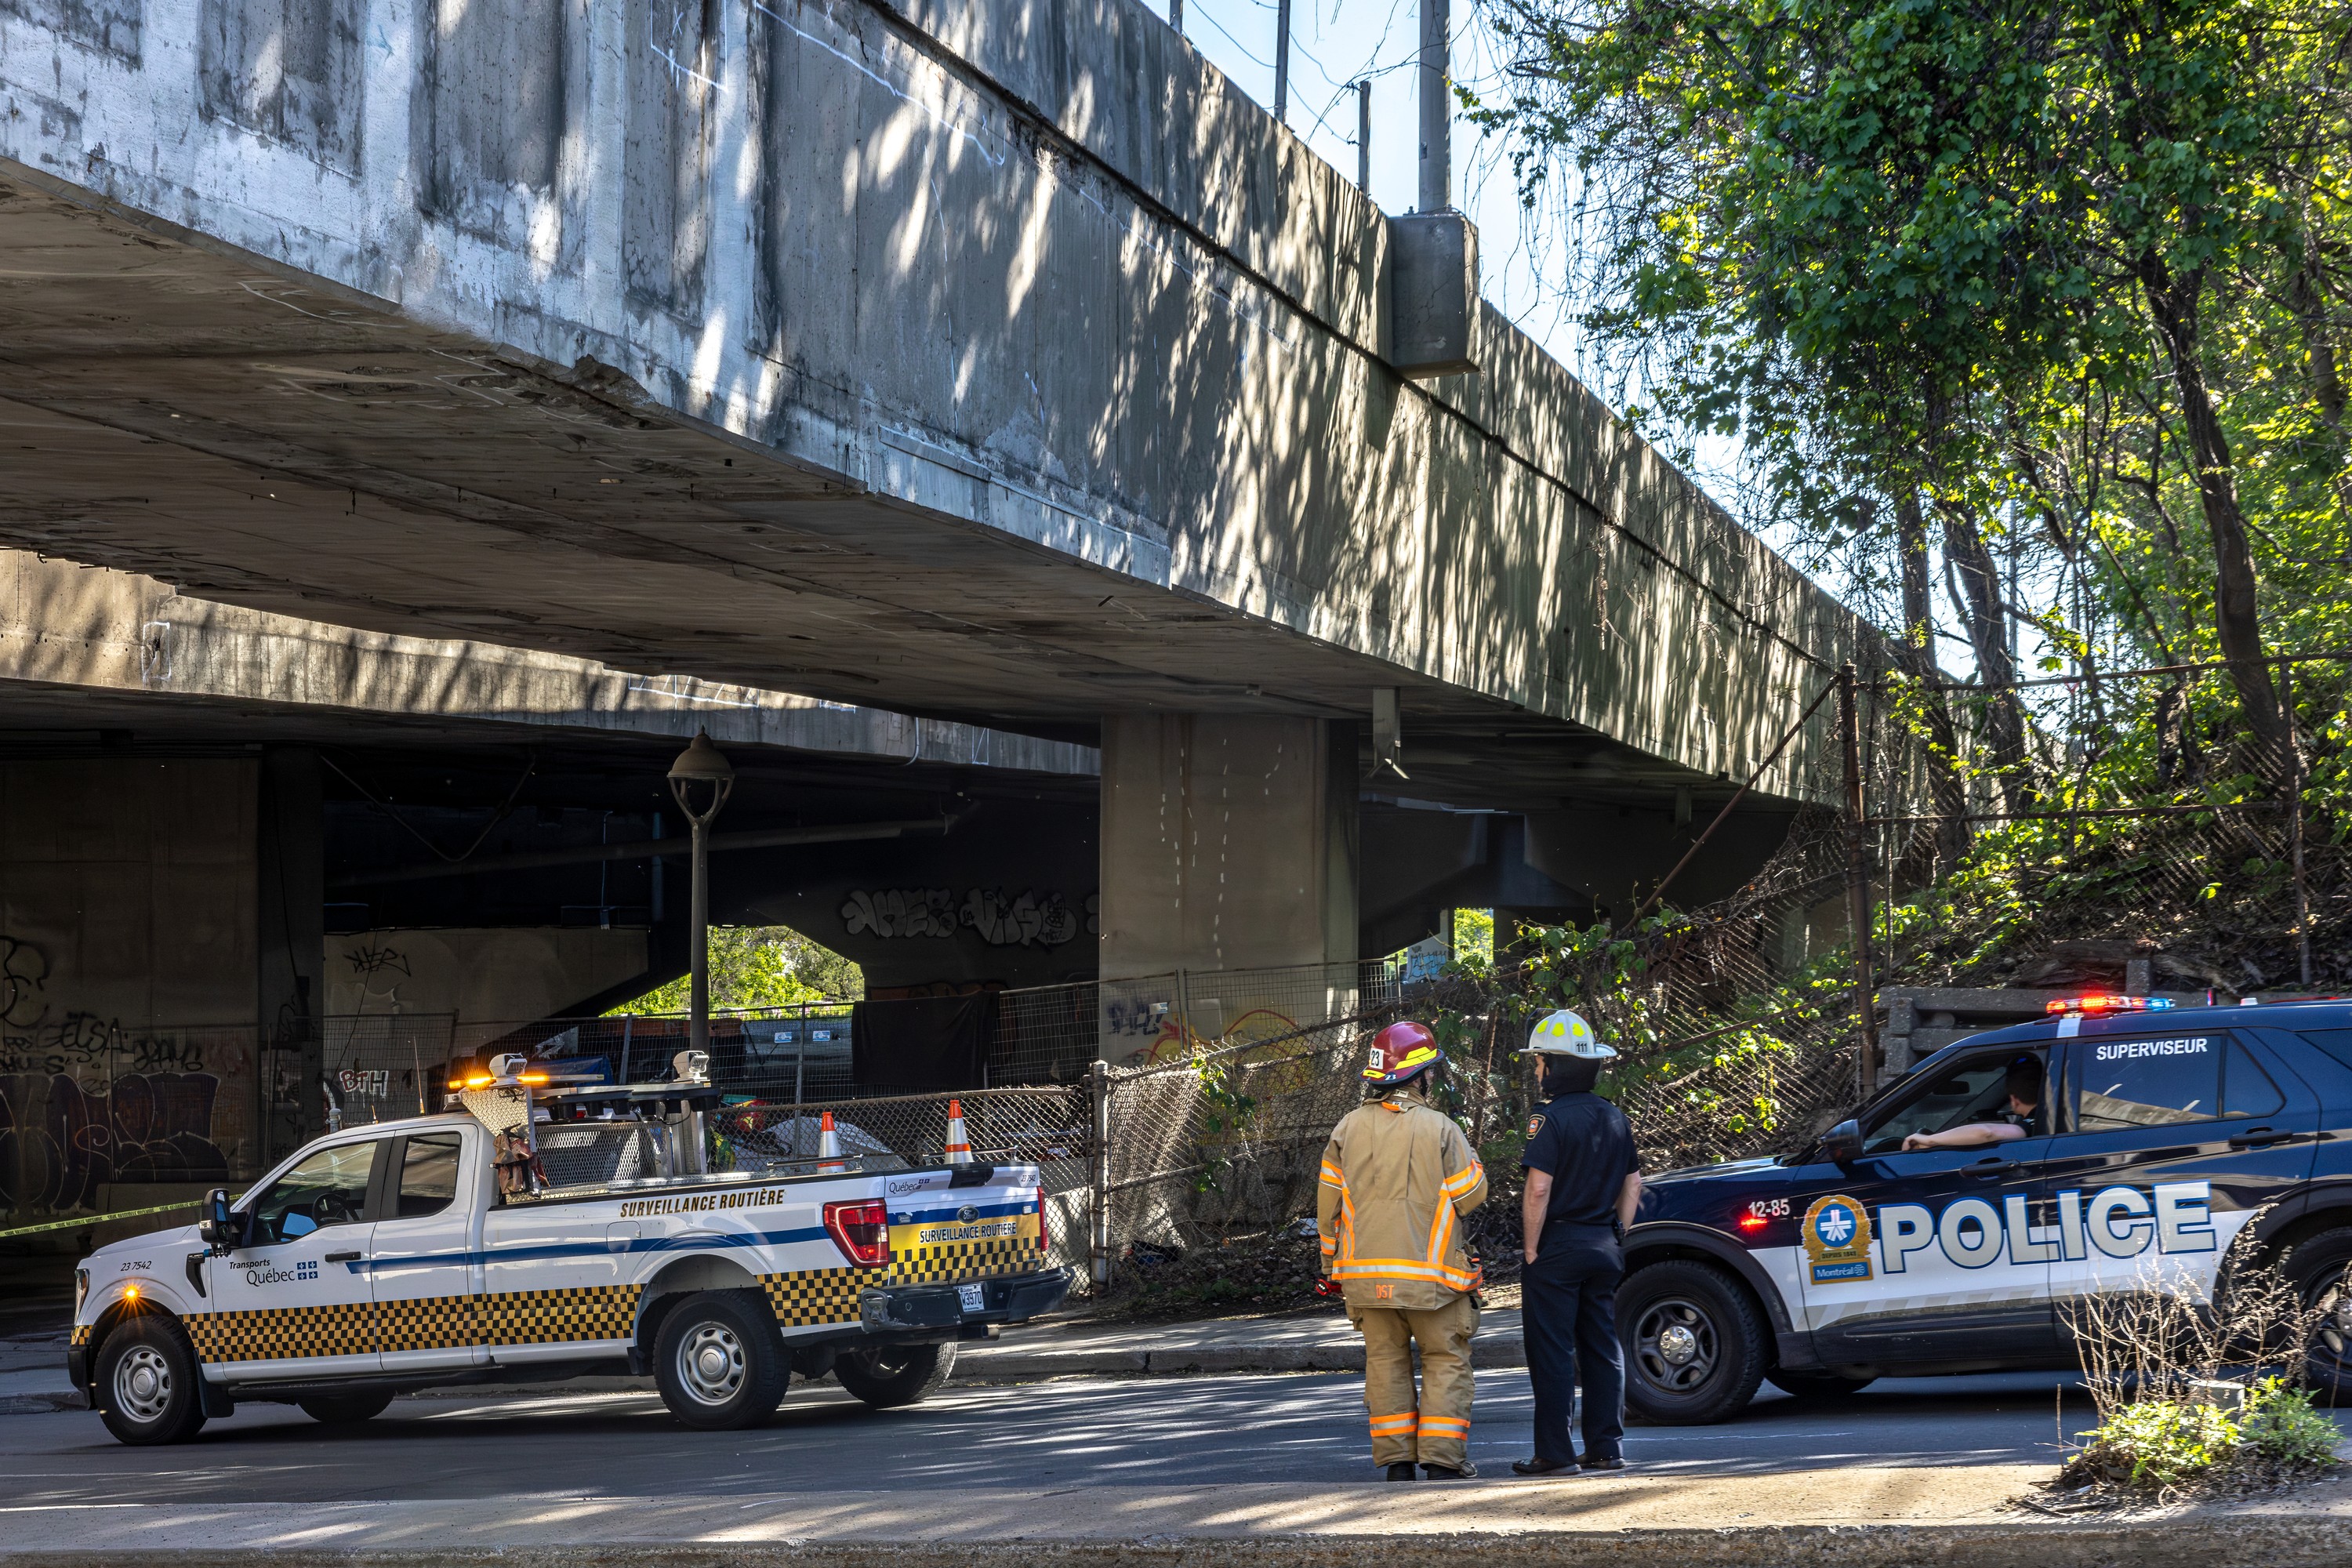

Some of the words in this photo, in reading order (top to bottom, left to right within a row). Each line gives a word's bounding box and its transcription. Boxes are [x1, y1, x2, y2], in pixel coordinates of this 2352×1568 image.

[1576, 1043, 1588, 1052] 111
[2096, 1038, 2208, 1061] SUPERVISEUR
[1370, 1050, 1380, 1066] 23
[339, 1069, 390, 1097] BTH
[889, 1180, 917, 1194] Québec
[620, 1195, 717, 1218] SURVEILLANCE
[719, 1188, 785, 1210] ROUTIÈRE
[1748, 1199, 1791, 1218] 12-85
[920, 1225, 979, 1243] SURVEILLANCE
[982, 1220, 1016, 1238] ROUTIÈRE
[1878, 1179, 2217, 1274] POLICE
[121, 1262, 130, 1272] 23
[131, 1261, 152, 1271] 7542
[229, 1259, 270, 1270] Transports
[1817, 1267, 1854, 1277] Montréal
[246, 1268, 296, 1287] Québec
